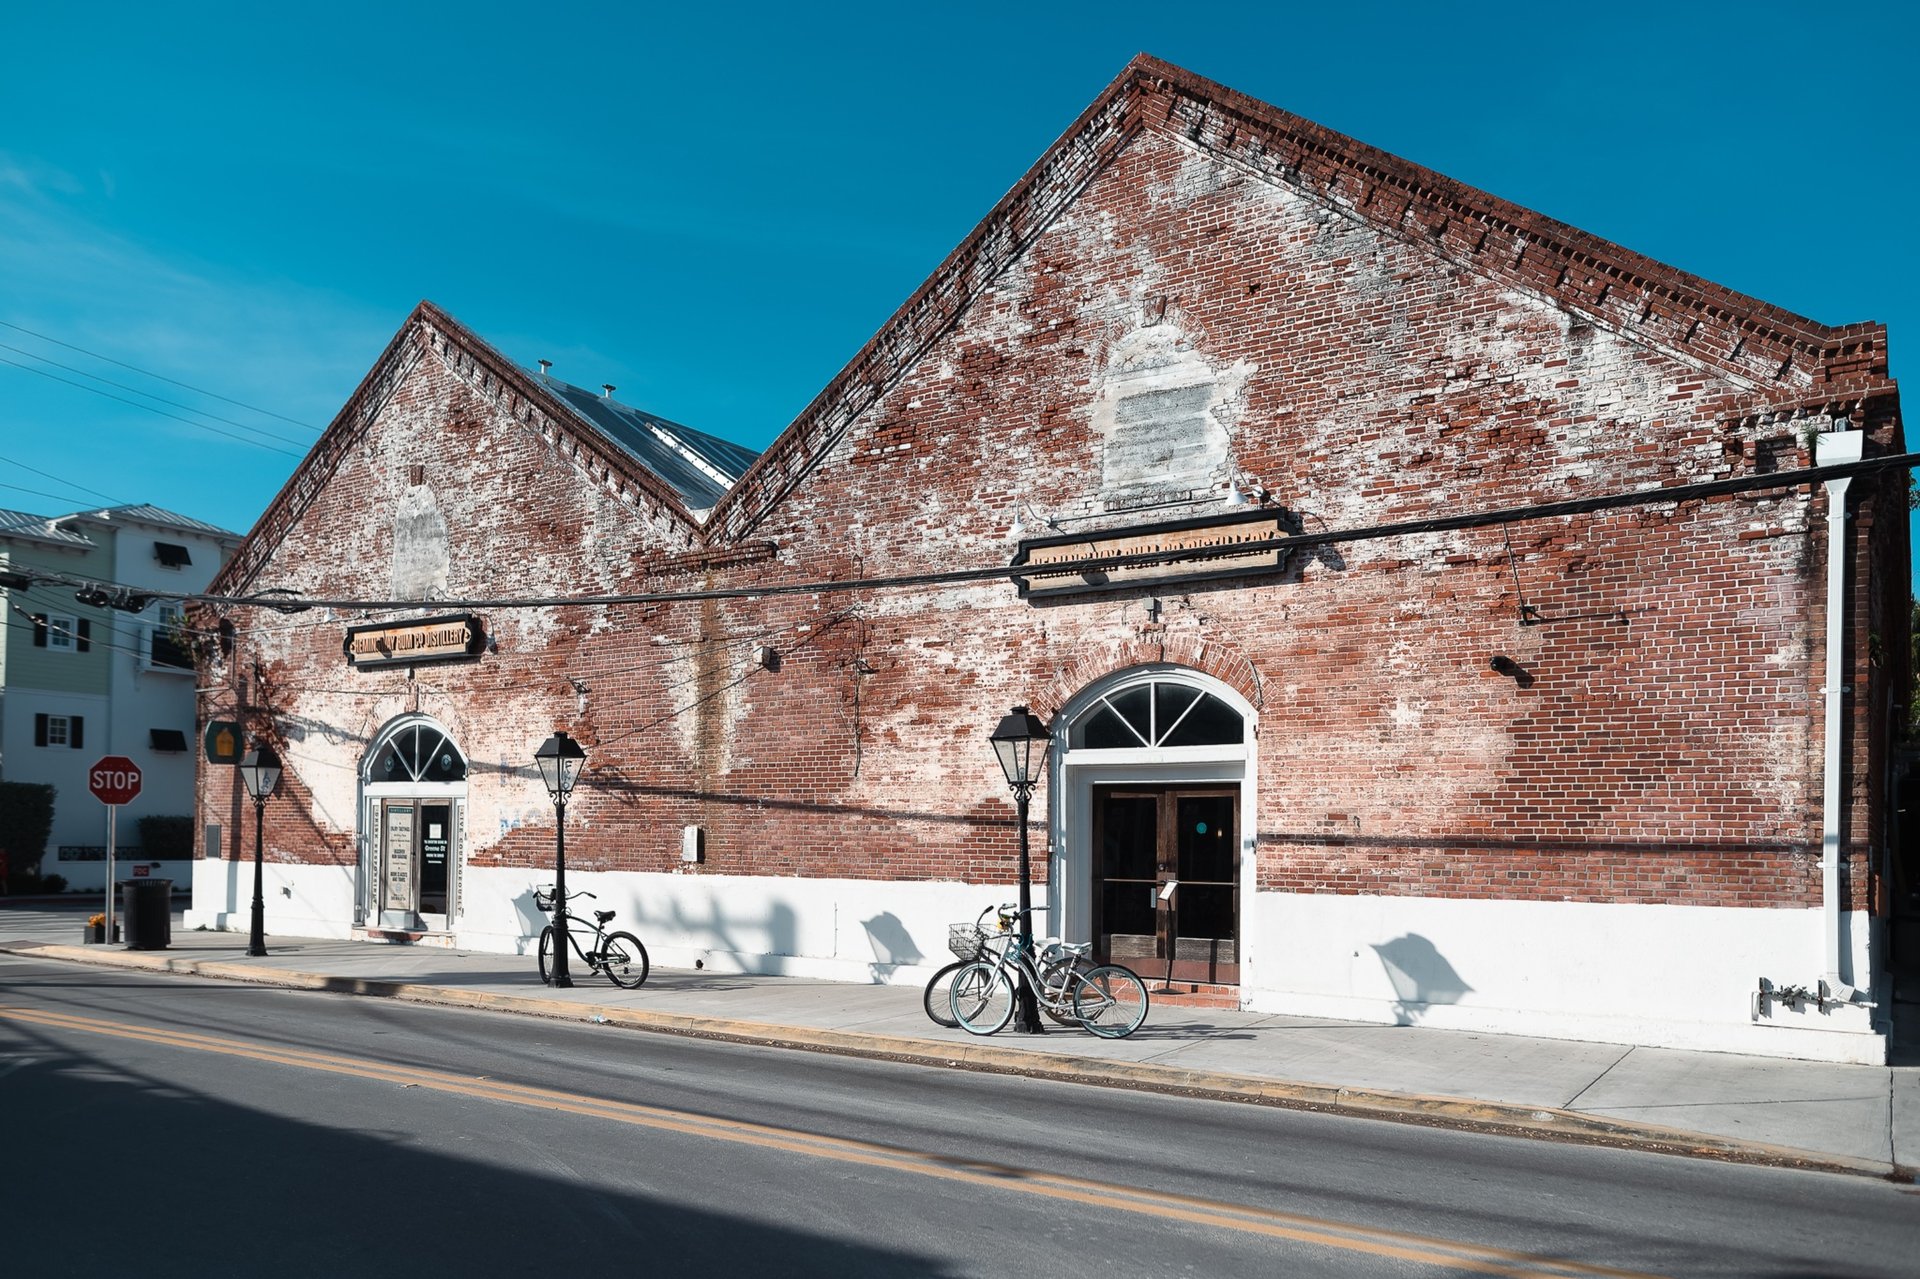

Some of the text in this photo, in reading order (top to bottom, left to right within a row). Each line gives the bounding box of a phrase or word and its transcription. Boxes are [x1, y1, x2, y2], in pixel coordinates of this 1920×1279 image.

[355, 636, 397, 654] HEMINAY
[398, 634, 414, 650] RUM
[426, 628, 465, 647] DISTILLERY
[92, 770, 139, 790] STOP
